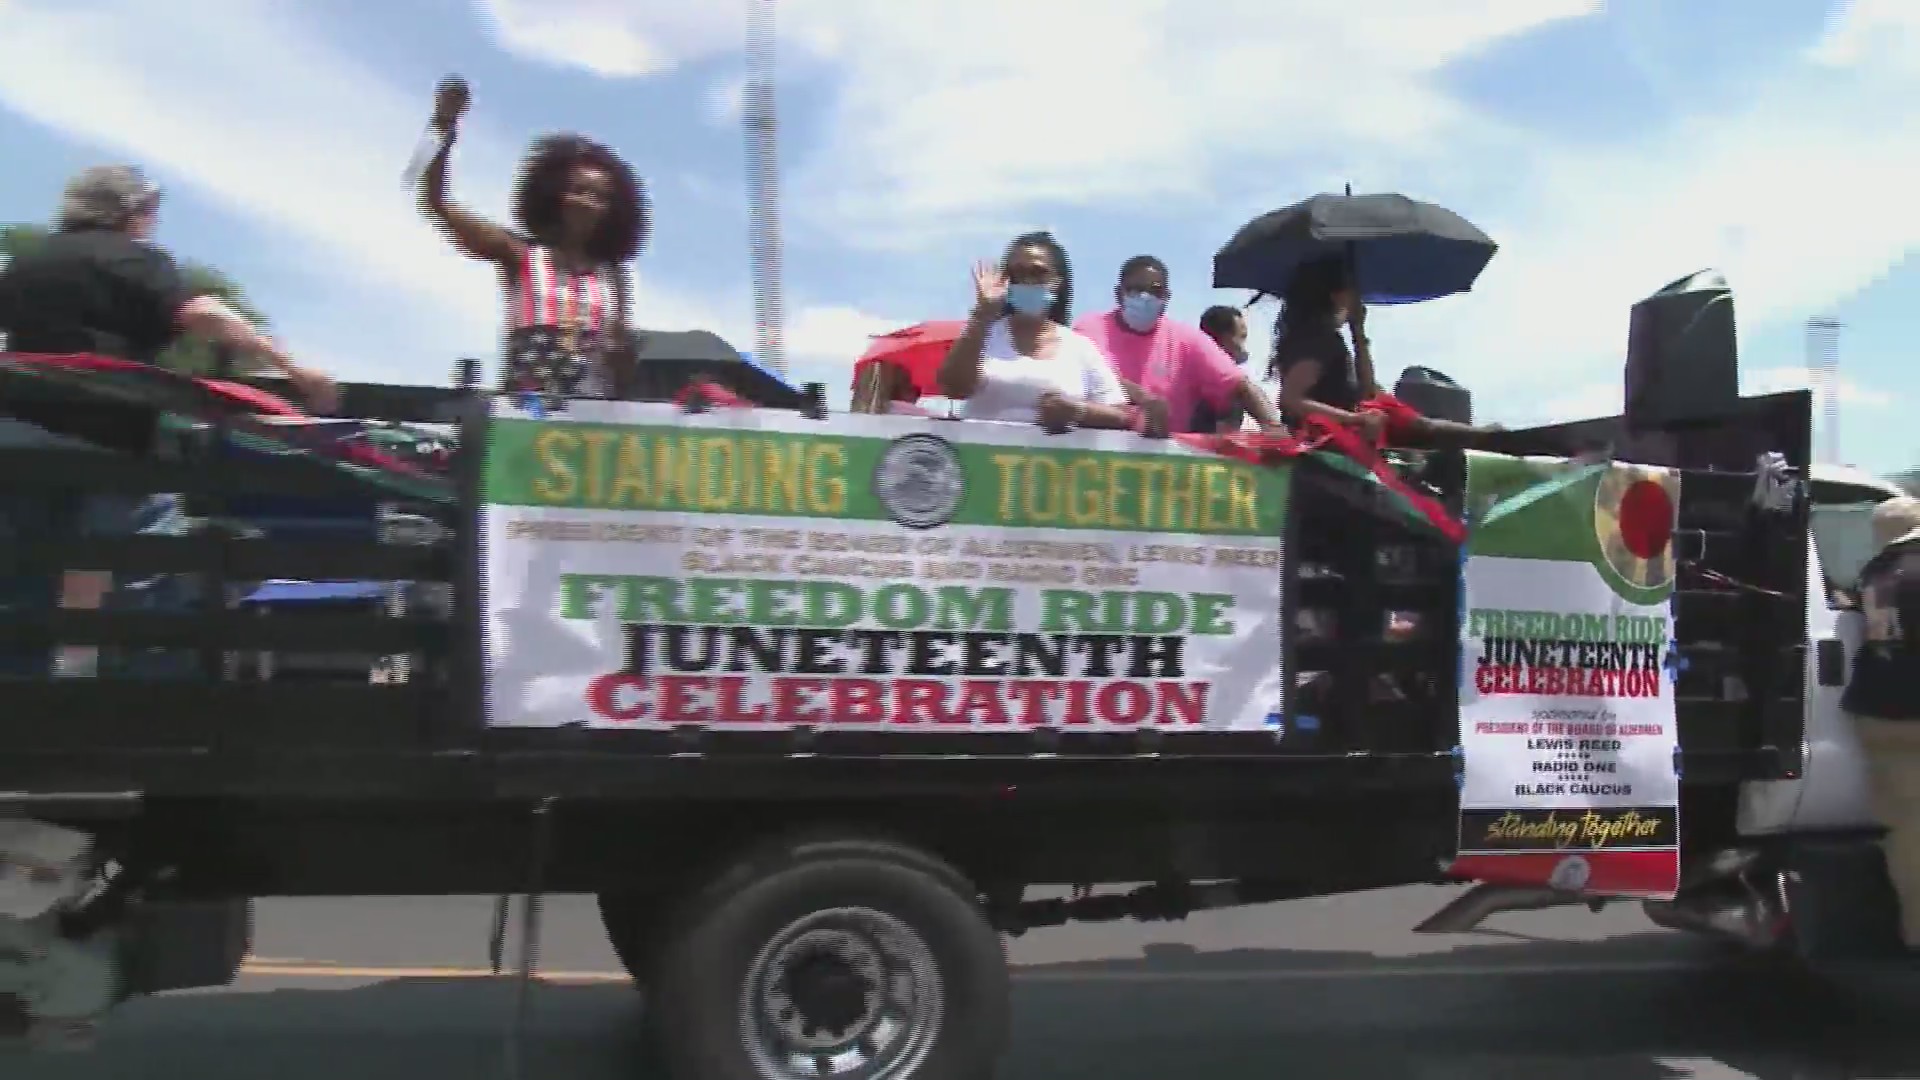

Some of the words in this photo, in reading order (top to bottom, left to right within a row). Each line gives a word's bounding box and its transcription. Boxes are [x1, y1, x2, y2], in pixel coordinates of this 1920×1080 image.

[531, 426, 845, 514] STANDING
[991, 454, 1260, 530] TOGETHER
[559, 572, 1015, 633] FREEDOM
[1039, 588, 1236, 635] RIDE
[1469, 608, 1609, 641] FREEDOM
[1615, 615, 1666, 644] RIDE
[620, 623, 1187, 678] JUNETEENTH
[1476, 636, 1660, 670] JUNETEENTH
[586, 673, 1211, 725] CELEBRATION
[1474, 665, 1660, 697] CELEBRATION
[1526, 739, 1574, 751] LEWIS
[1578, 740, 1622, 752] REED
[1532, 760, 1579, 773] RADIO
[1582, 761, 1617, 773] ONE
[1514, 784, 1566, 796] BLACK
[1569, 784, 1633, 796] CAUCUS
[1485, 810, 1578, 850] standing
[1579, 808, 1662, 849] together
